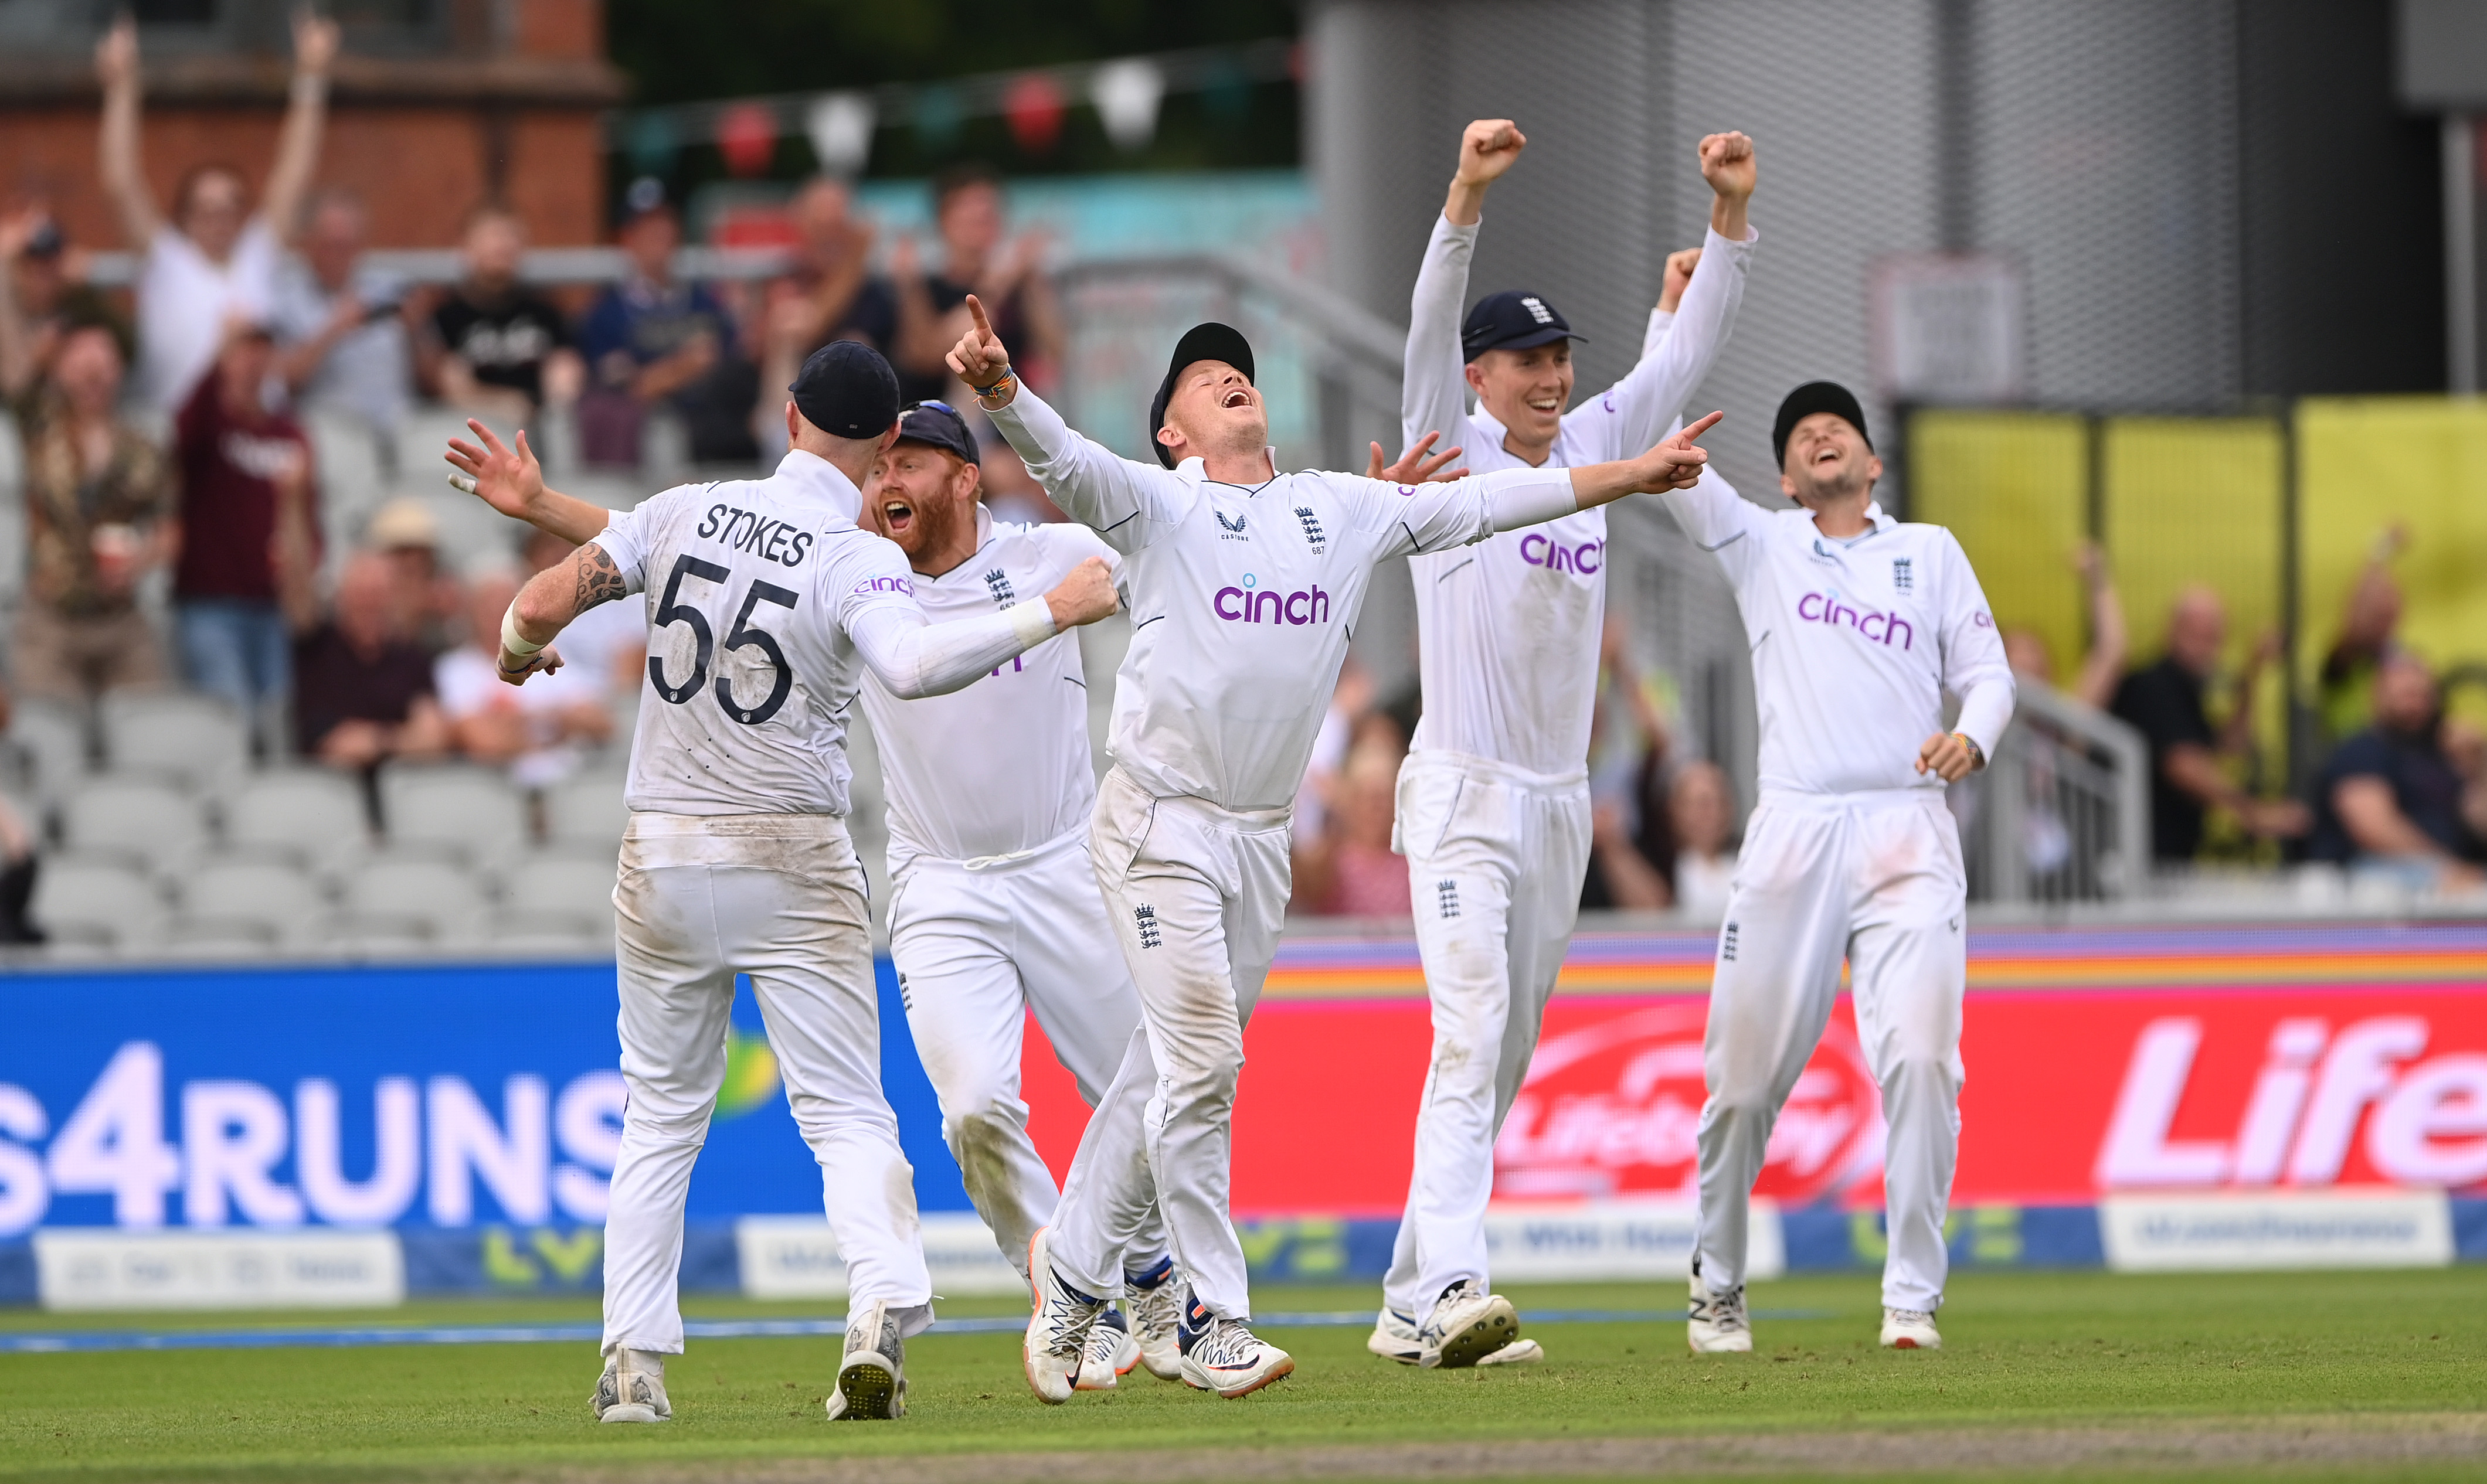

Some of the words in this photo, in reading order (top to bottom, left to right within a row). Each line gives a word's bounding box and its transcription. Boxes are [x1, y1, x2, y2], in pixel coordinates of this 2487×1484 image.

[697, 503, 813, 568] STOKES
[1221, 533, 1249, 542] CASTORE
[1312, 546, 1325, 556] 687
[1213, 573, 1330, 625] cinch
[1798, 588, 1914, 651] cinch
[648, 553, 799, 725] 55
[2091, 1013, 2487, 1187] Life
[482, 1225, 604, 1281] LV
